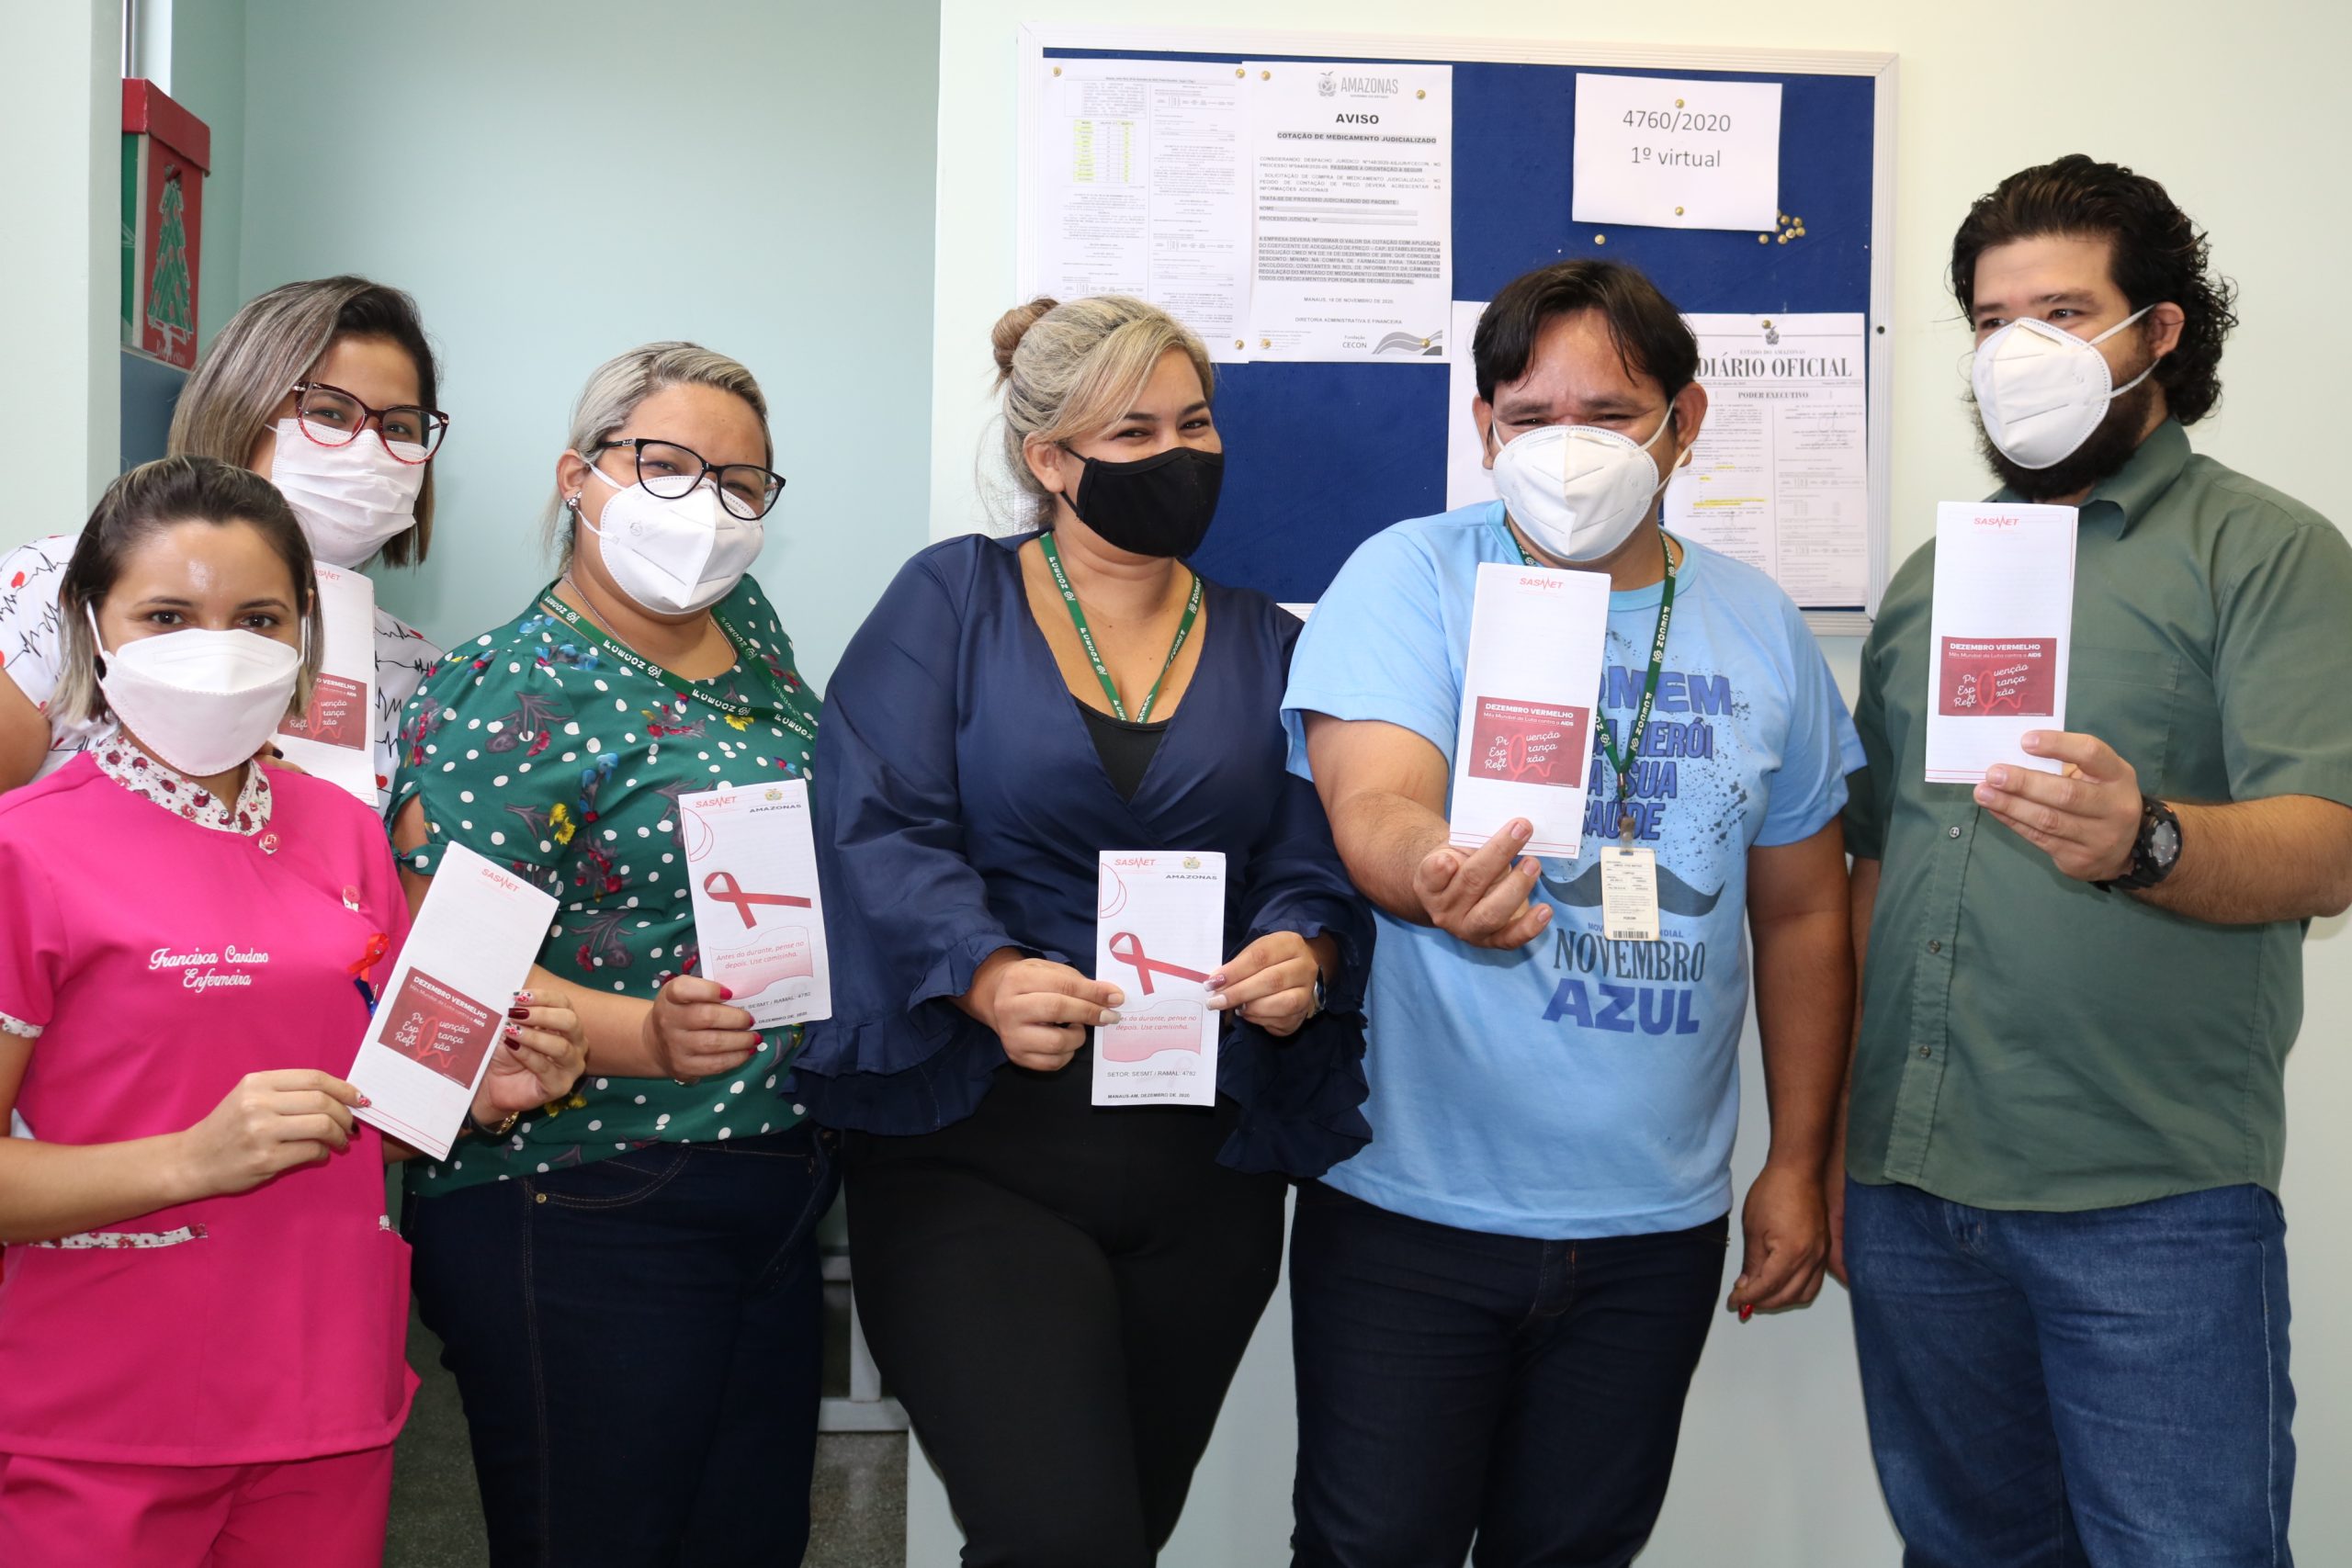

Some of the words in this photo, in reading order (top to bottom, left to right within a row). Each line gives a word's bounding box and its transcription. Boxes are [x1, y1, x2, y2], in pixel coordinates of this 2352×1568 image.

[1341, 77, 1398, 95] AMAZONAS
[1336, 114, 1380, 124] AVISO
[1623, 110, 1731, 132] 4760/2020
[1277, 131, 1312, 140] COTAÇÃO
[1658, 149, 1721, 167] virtual
[1697, 352, 1765, 378] DIÁRIO
[1771, 357, 1852, 378] OFICIAL
[1657, 606, 1670, 648] FCECON
[603, 639, 647, 670] FCECON
[322, 678, 356, 691] VERMELHO
[1599, 666, 1733, 716] MEM
[692, 688, 737, 713] FCECON
[1485, 704, 1529, 714] DEZEMBRO
[1531, 708, 1573, 718] VERMELHO
[1635, 692, 1653, 736] FCECON
[774, 714, 814, 741] FCECON
[1624, 761, 1677, 799] SUA
[749, 804, 802, 813] AMAZONAS
[149, 947, 218, 970] Francisca
[225, 944, 269, 964] Cardoso
[1554, 928, 1705, 982] NOVEMBRO
[183, 968, 252, 993] Enfermeira
[413, 976, 451, 999] DEZEMBRO
[451, 996, 488, 1020] VERMELHO
[1542, 977, 1700, 1035] AZUL
